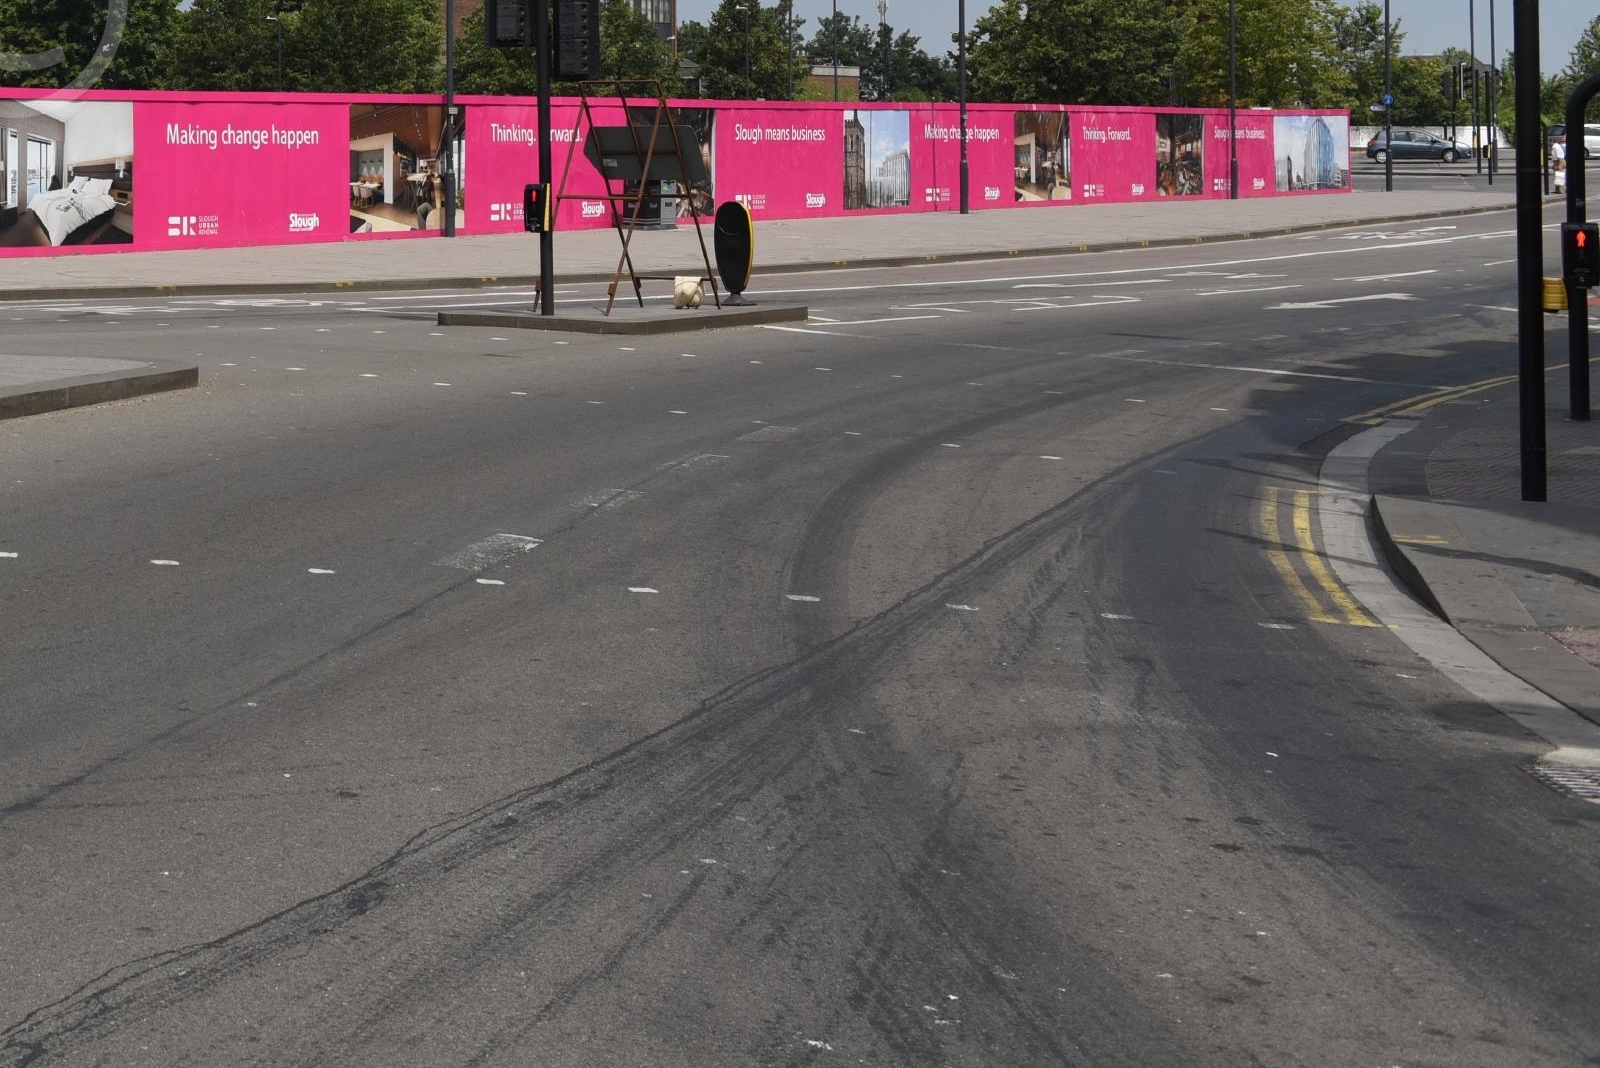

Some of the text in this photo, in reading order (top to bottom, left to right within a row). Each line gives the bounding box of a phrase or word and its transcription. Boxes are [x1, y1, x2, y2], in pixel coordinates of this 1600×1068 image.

[166, 123, 319, 150] Making change happen
[490, 123, 583, 146] Thinking. rward.
[735, 123, 826, 144] Slough means business
[924, 124, 1000, 143] Making chage happen
[1082, 125, 1132, 143] Thinking. Forward.
[582, 201, 605, 218] Slough
[806, 193, 826, 208] Slough
[289, 212, 320, 231] Slough
